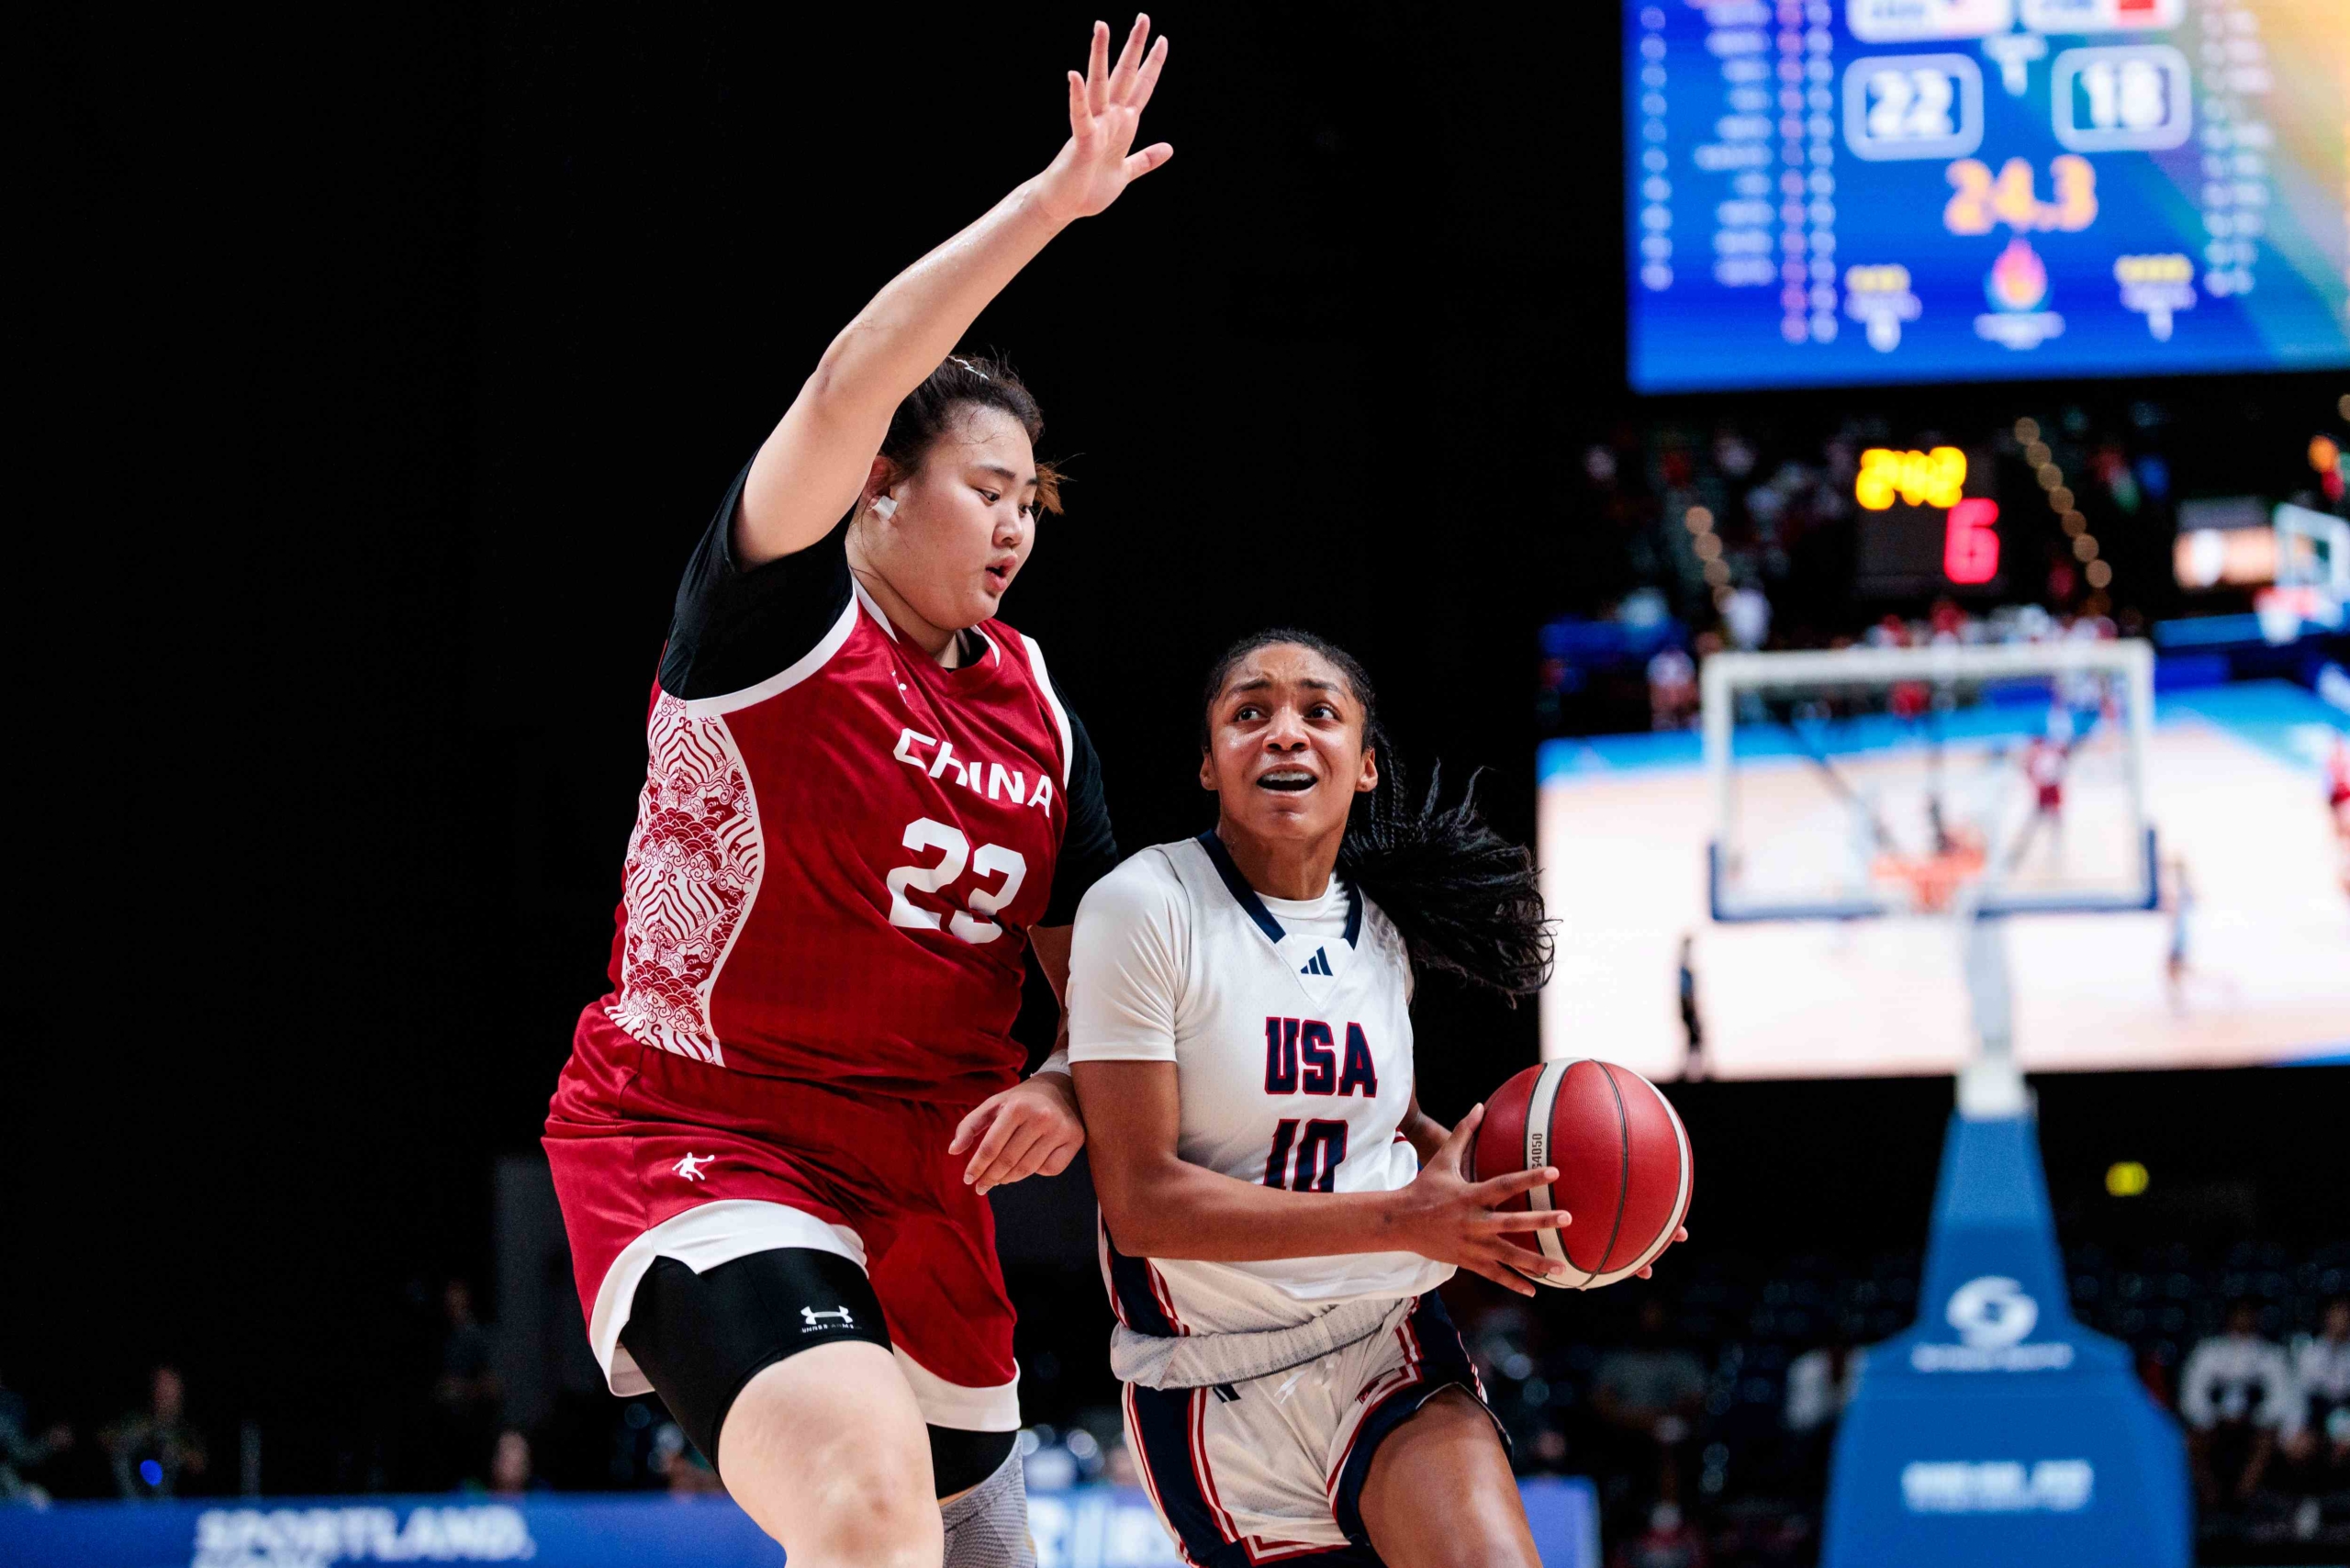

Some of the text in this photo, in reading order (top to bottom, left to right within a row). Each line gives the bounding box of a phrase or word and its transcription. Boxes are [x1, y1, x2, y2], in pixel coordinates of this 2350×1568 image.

[1867, 69, 1954, 138] 22
[2079, 60, 2165, 129] 18
[1943, 498, 1999, 584] 6
[893, 727, 1053, 818] CHINA
[887, 817, 1027, 944] 23
[1264, 1016, 1378, 1098] USA
[1260, 1118, 1348, 1193] 10
